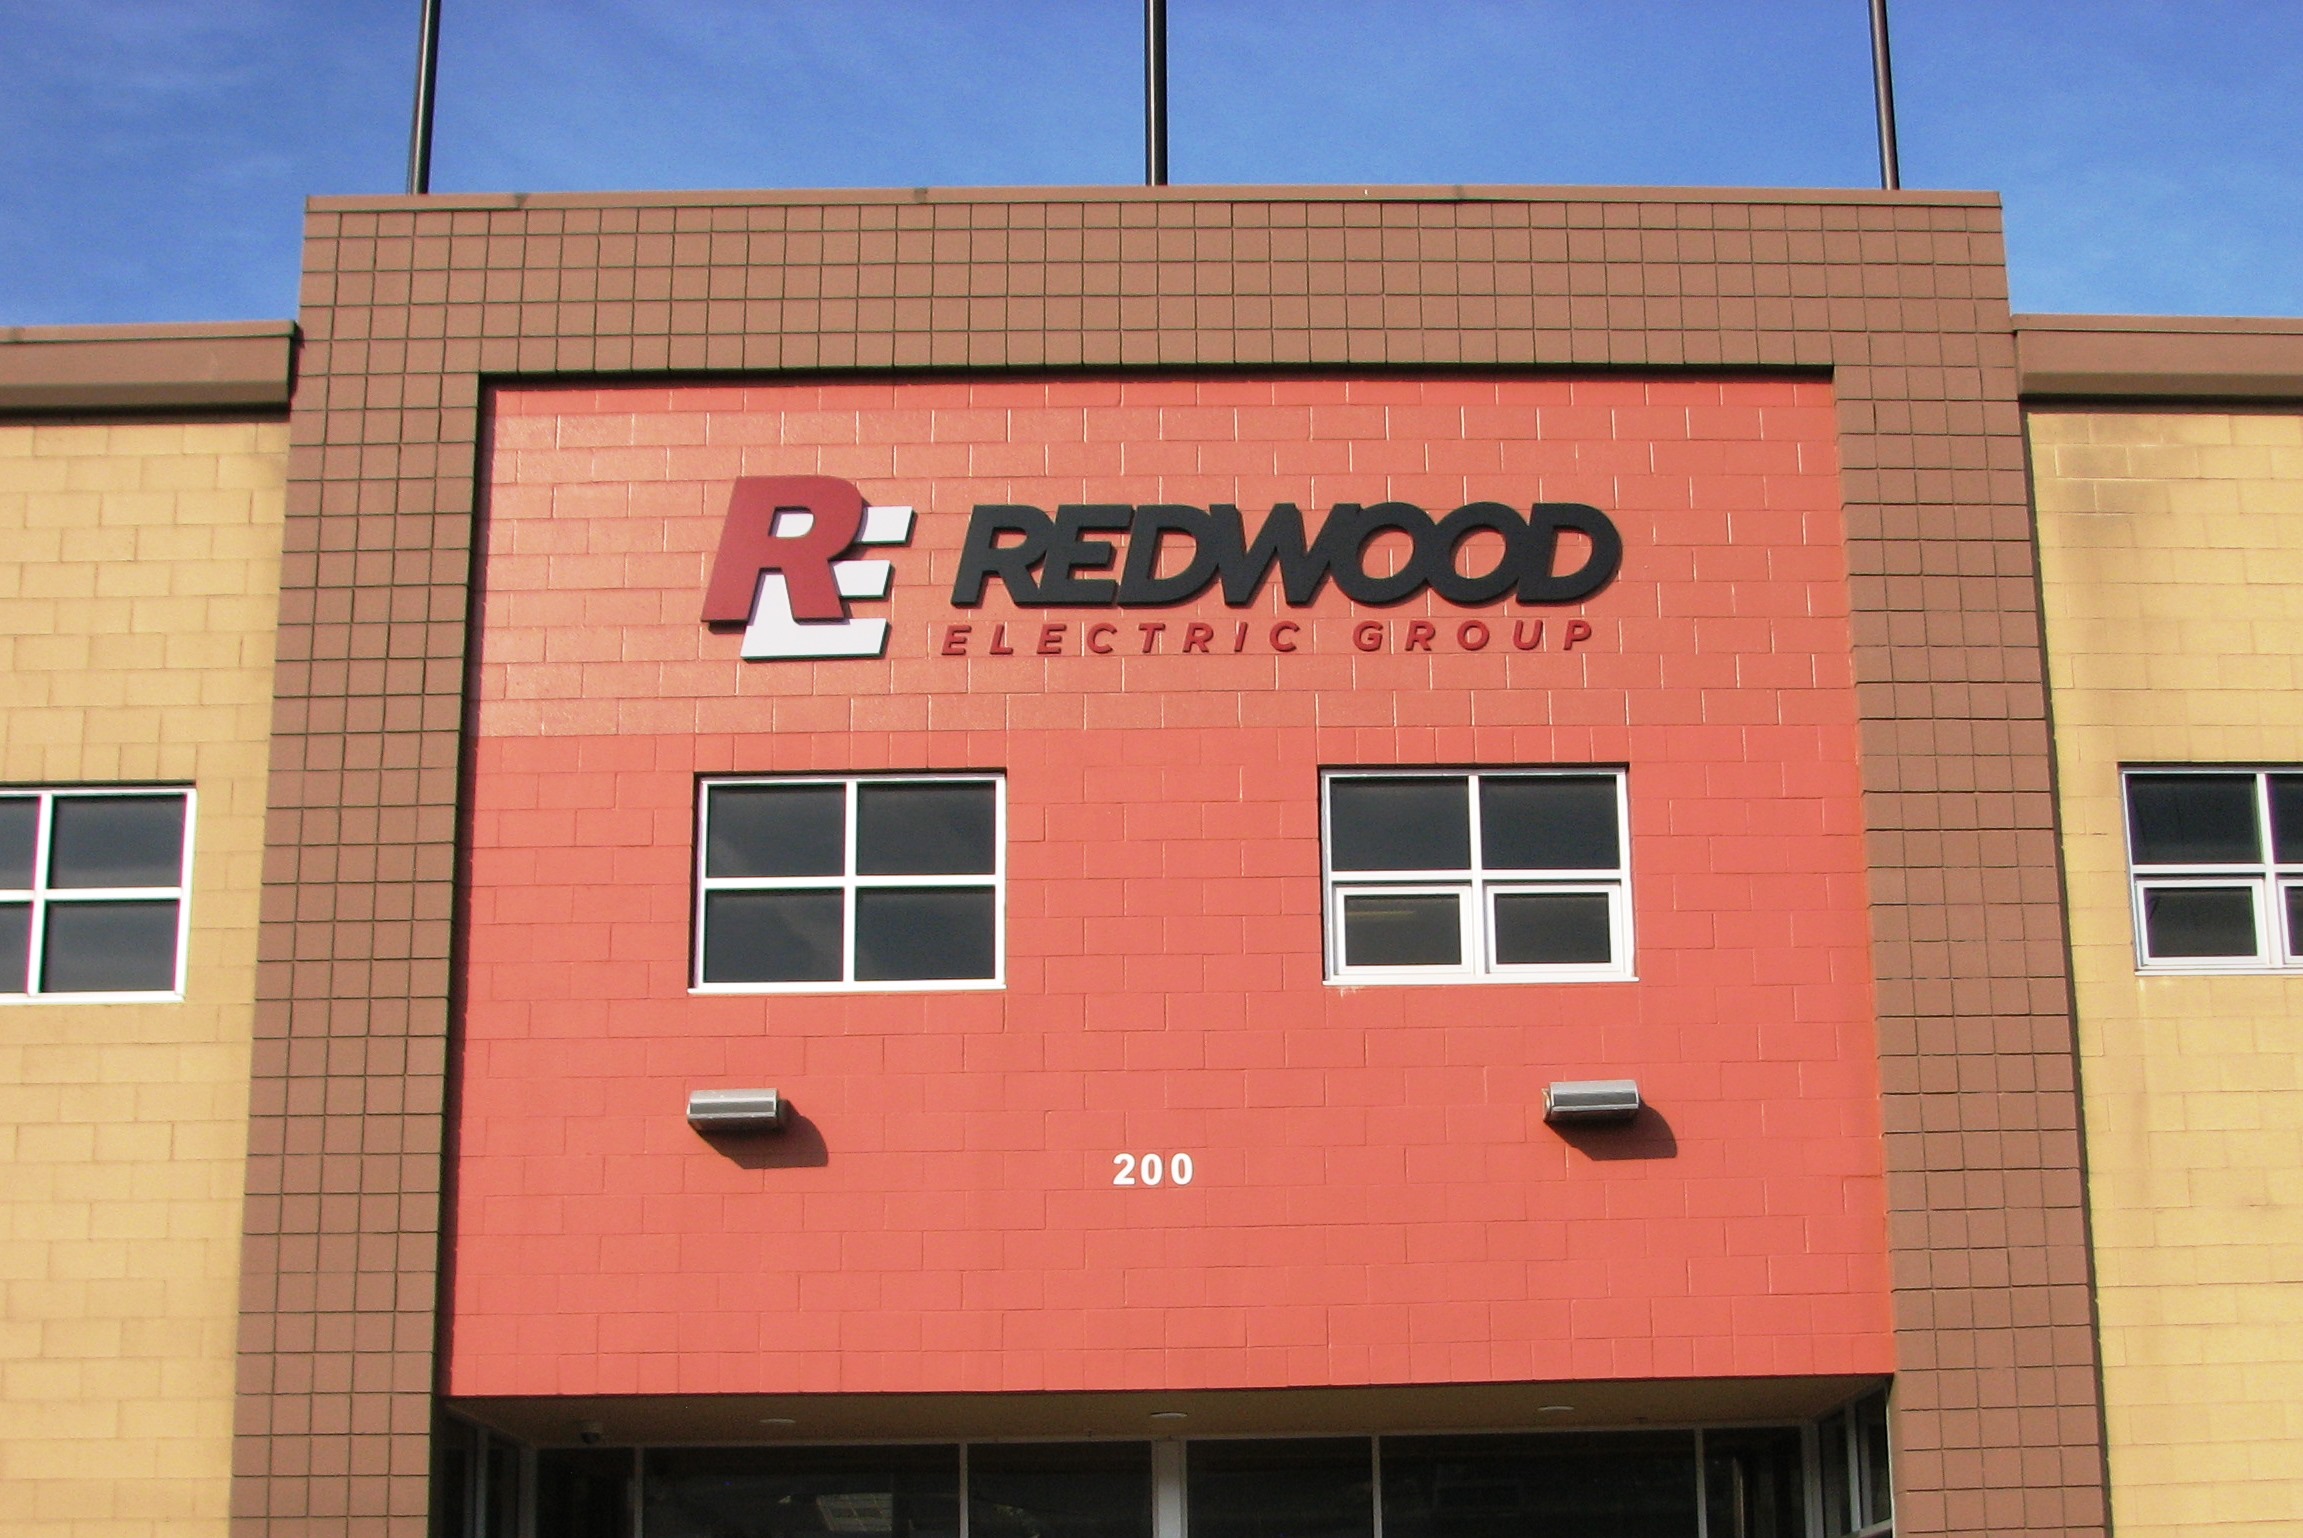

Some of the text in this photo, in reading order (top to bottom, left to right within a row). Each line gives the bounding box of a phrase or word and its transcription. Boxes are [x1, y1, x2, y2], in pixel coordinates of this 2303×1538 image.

[950, 501, 1623, 608] REDWOOD
[941, 619, 1592, 655] ELECTRIC GROUP
[1112, 1152, 1194, 1186] 200
